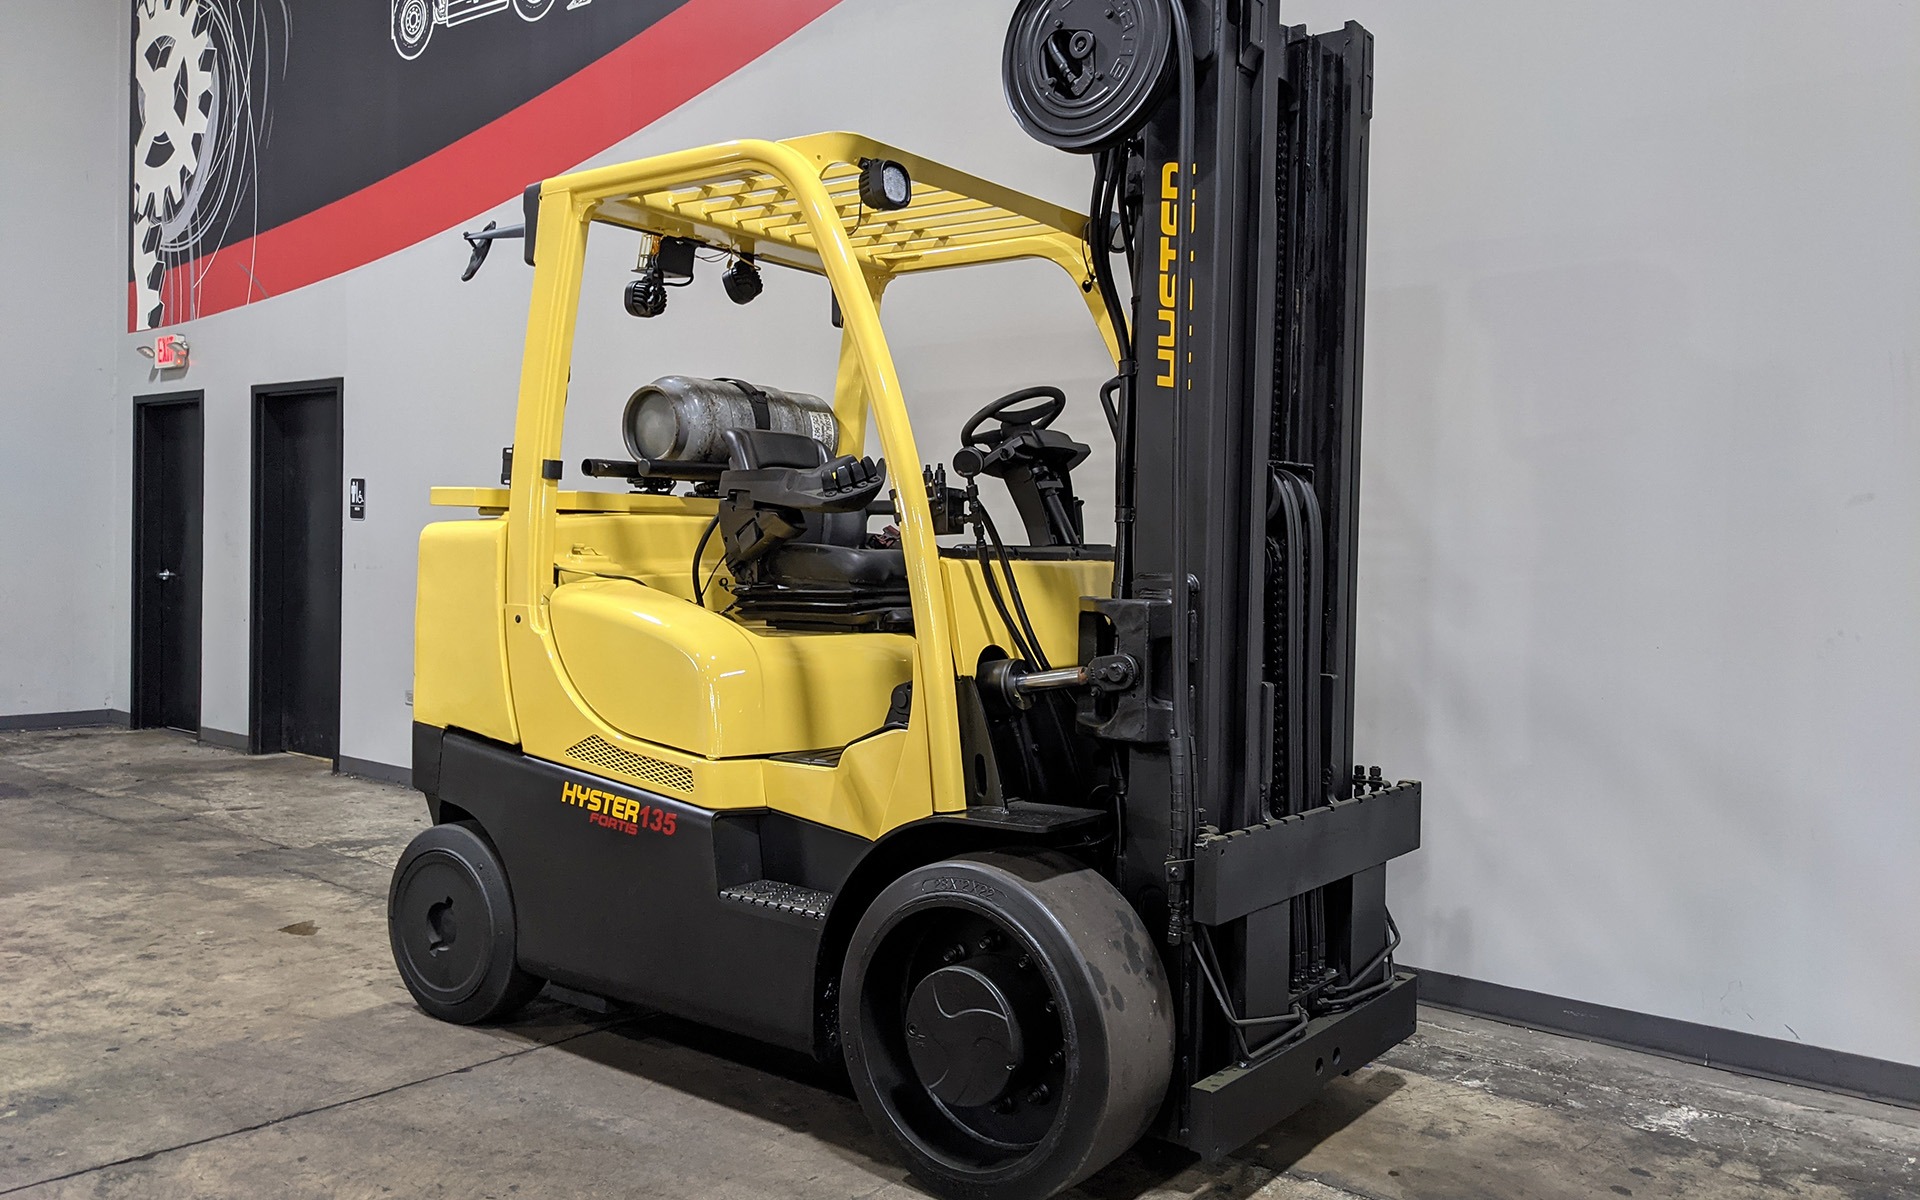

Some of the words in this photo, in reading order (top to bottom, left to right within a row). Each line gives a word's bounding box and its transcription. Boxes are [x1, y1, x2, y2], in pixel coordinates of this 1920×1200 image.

[561, 781, 641, 823] HYSTER
[640, 805, 678, 836] 135
[589, 812, 638, 836] FORTIS
